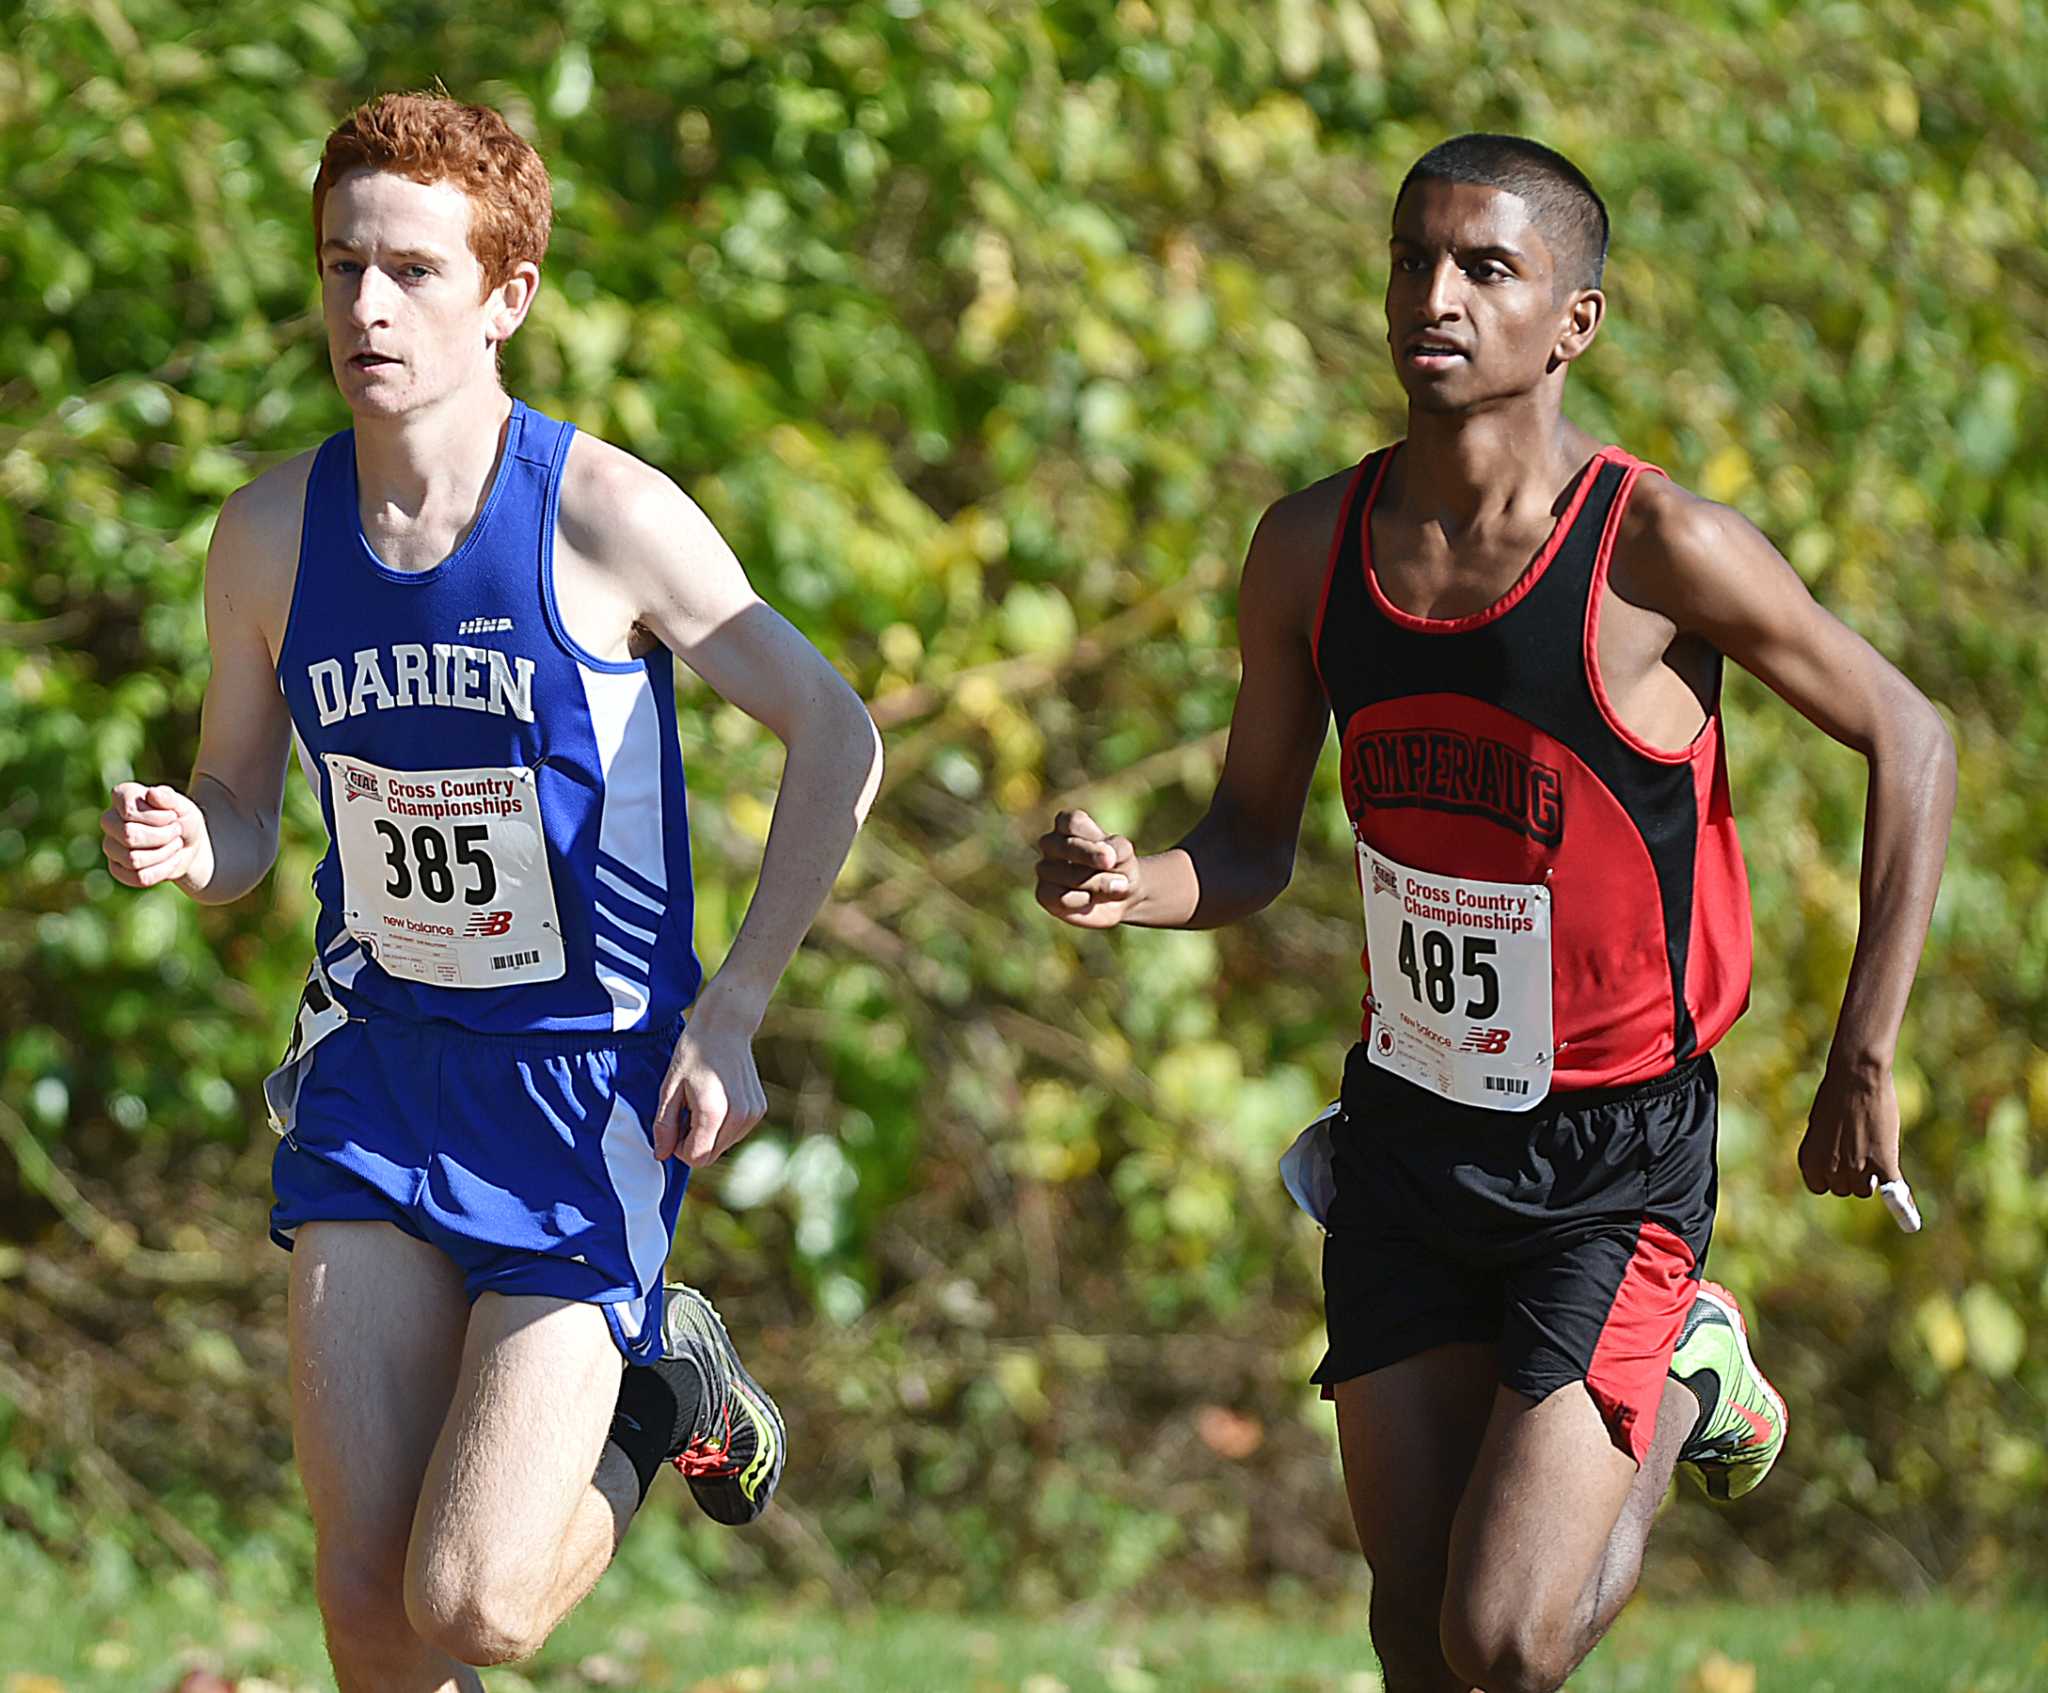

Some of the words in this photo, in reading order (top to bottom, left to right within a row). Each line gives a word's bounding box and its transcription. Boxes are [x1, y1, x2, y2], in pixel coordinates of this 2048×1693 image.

[308, 643, 536, 727] DARIEN
[350, 771, 378, 791] CIAC
[388, 778, 436, 798] Cross
[440, 778, 515, 797] Country
[387, 797, 523, 820] Championships
[374, 819, 497, 906] 385
[1406, 878, 1450, 904] Cross
[1455, 888, 1528, 914] Country
[383, 915, 405, 928] new
[407, 916, 455, 936] balance
[1404, 896, 1534, 934] Championships
[1399, 919, 1500, 1021] 485
